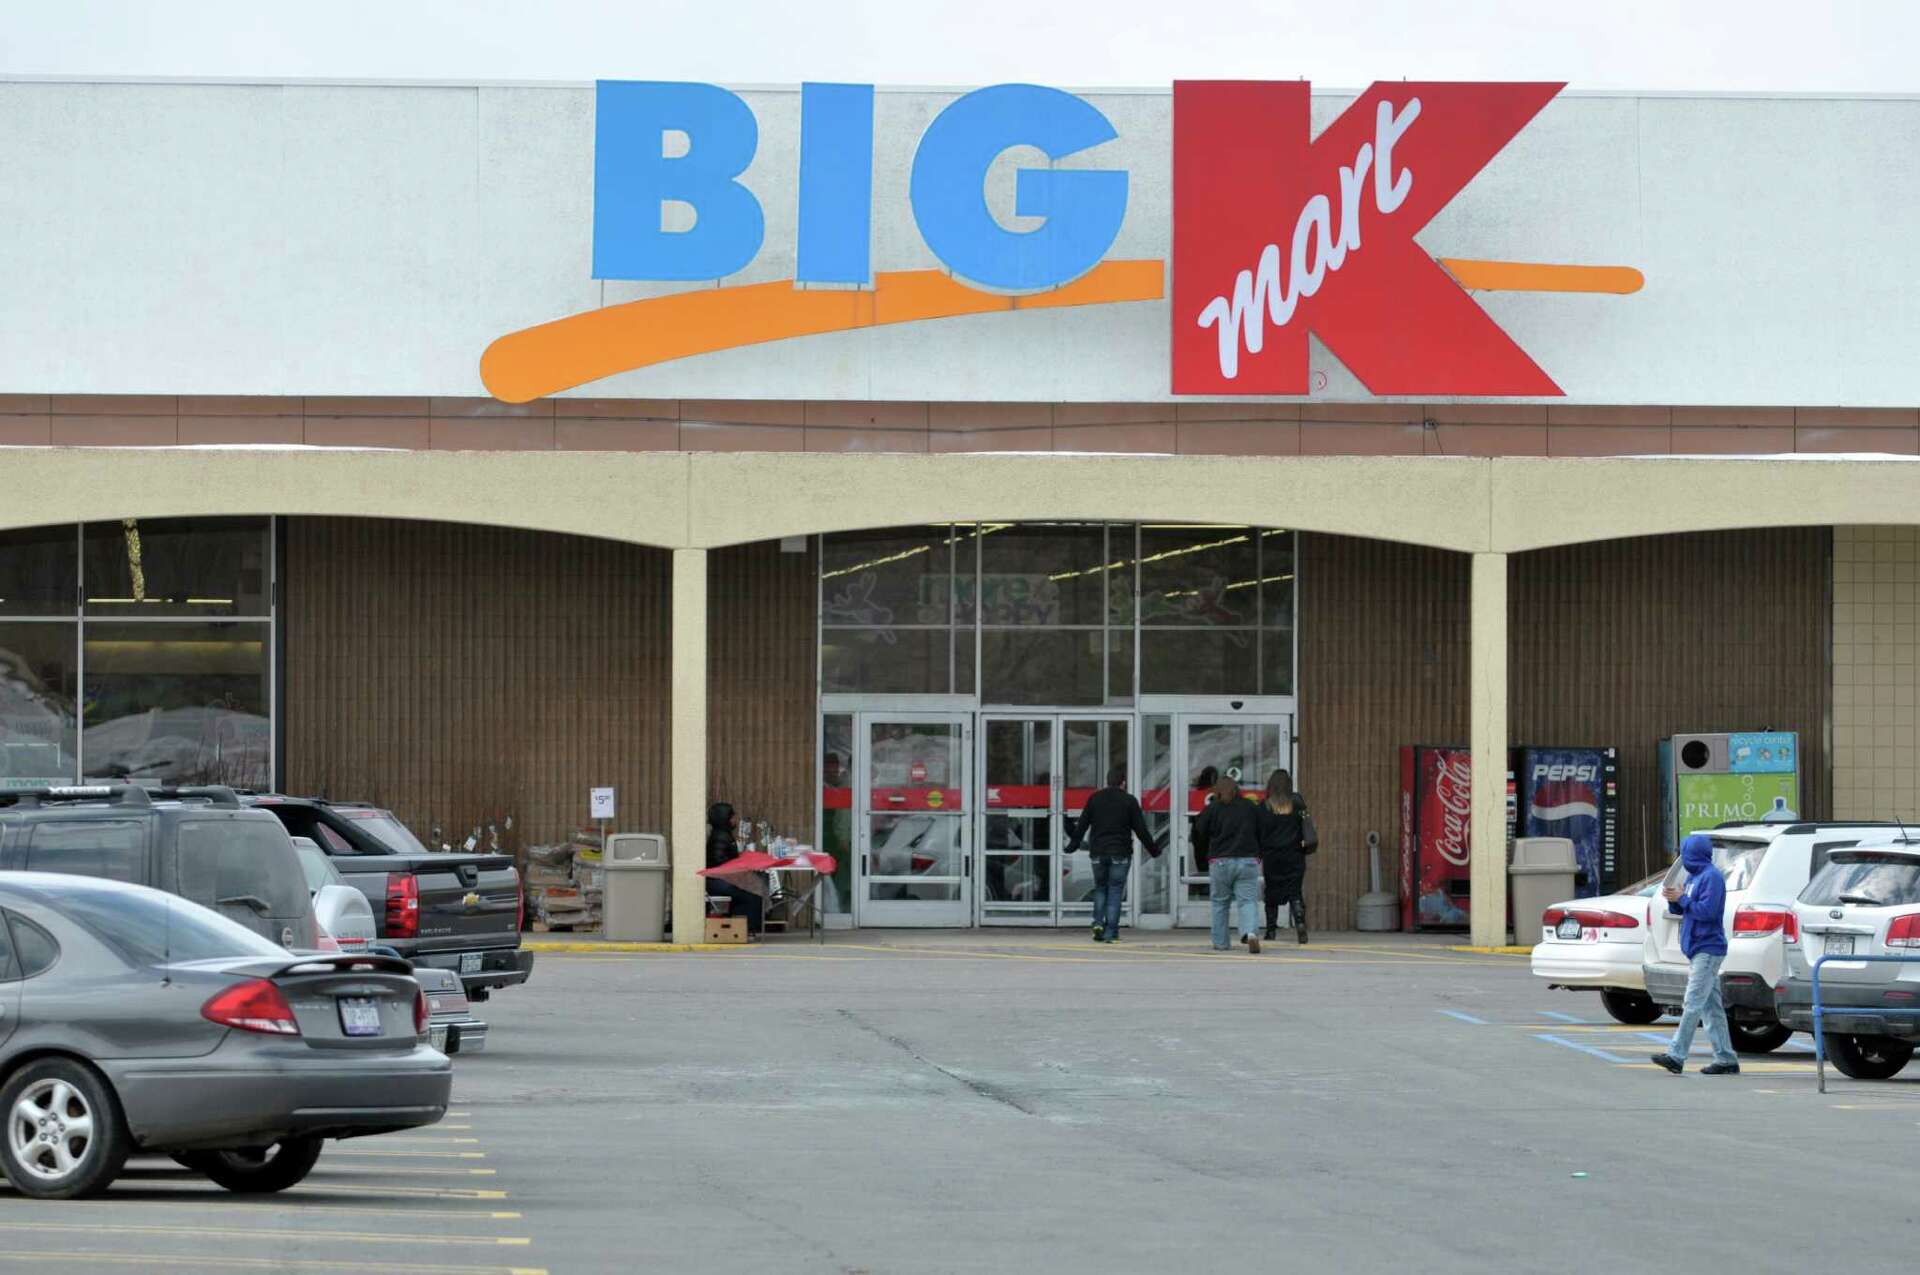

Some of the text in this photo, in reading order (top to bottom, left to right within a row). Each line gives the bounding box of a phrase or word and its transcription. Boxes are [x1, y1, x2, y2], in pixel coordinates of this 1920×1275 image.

[592, 80, 1568, 396] BIG K
[1197, 98, 1421, 379] mart
[1533, 765, 1597, 782] PEPSI
[1685, 802, 1757, 818] PRIMO
